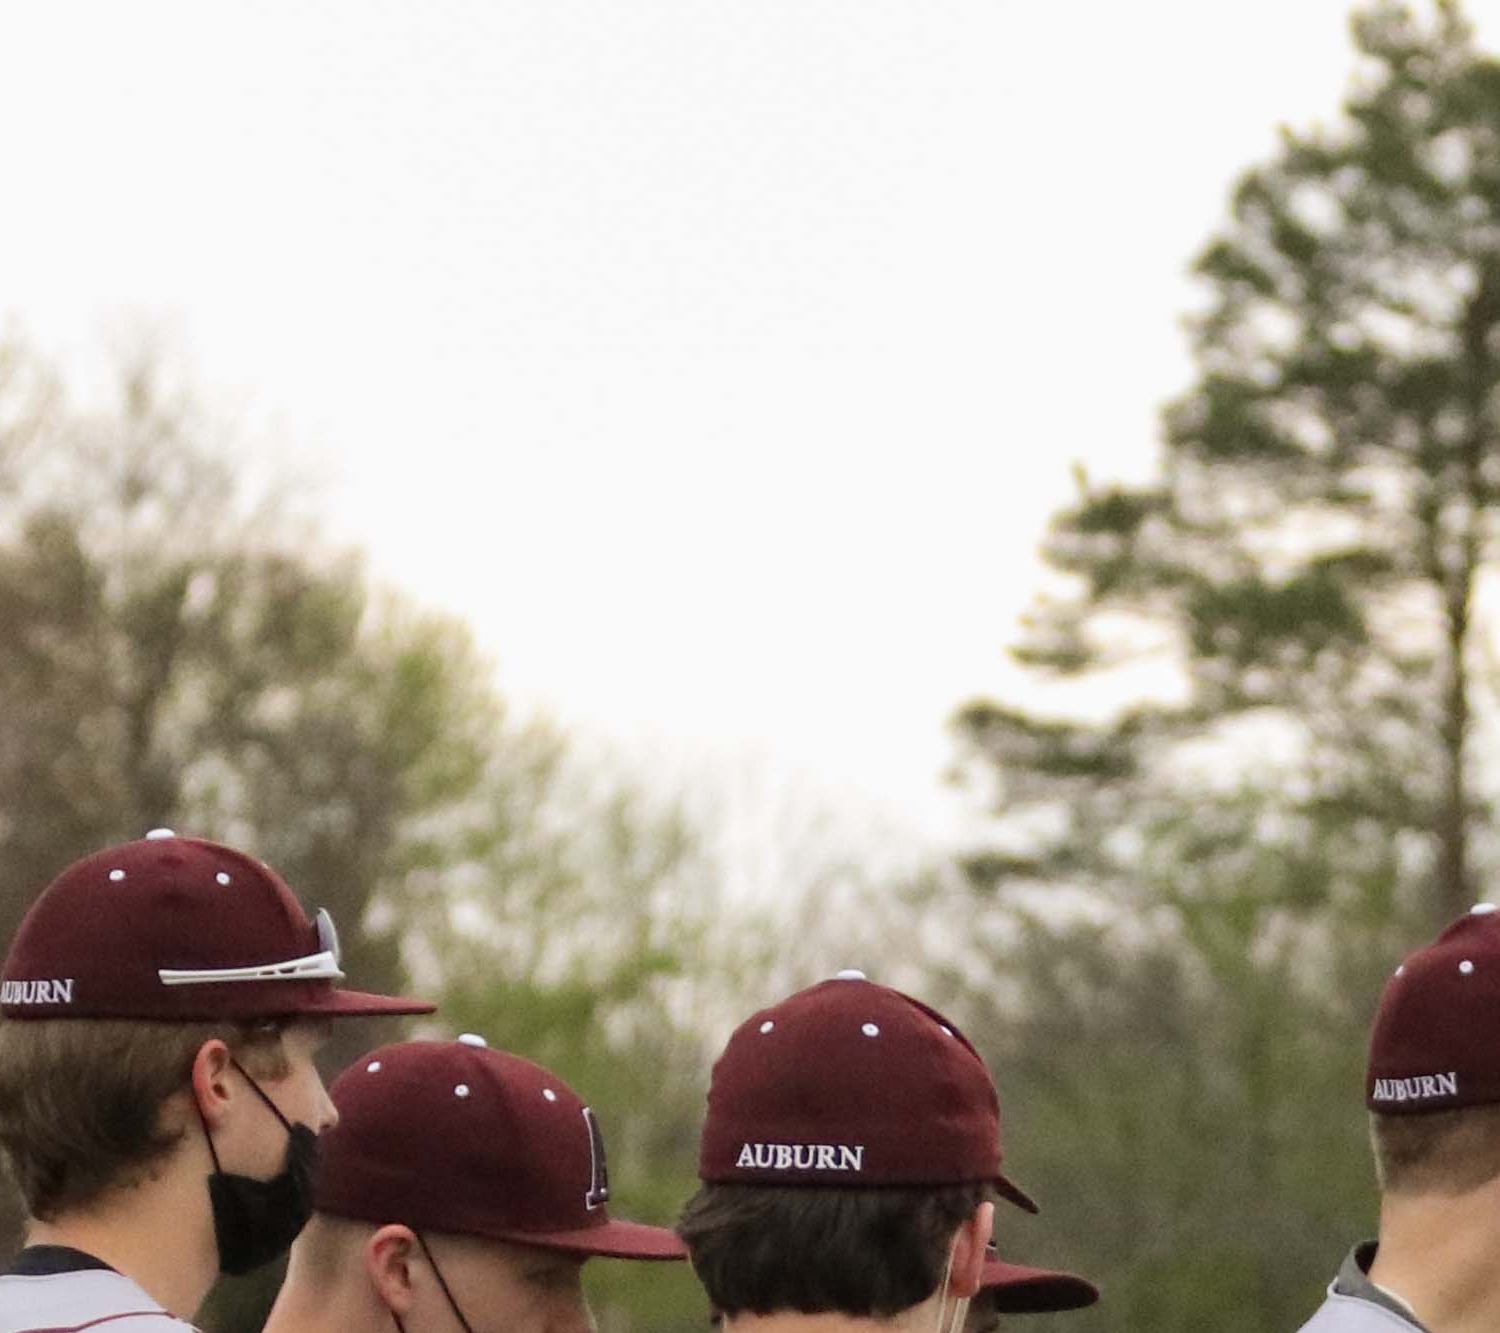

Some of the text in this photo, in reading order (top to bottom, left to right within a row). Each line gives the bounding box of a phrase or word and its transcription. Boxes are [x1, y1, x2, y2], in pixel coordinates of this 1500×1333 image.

[0, 977, 75, 1006] AUBURN
[1372, 1070, 1458, 1103] AUBURN
[735, 1142, 865, 1174] AUBURN
